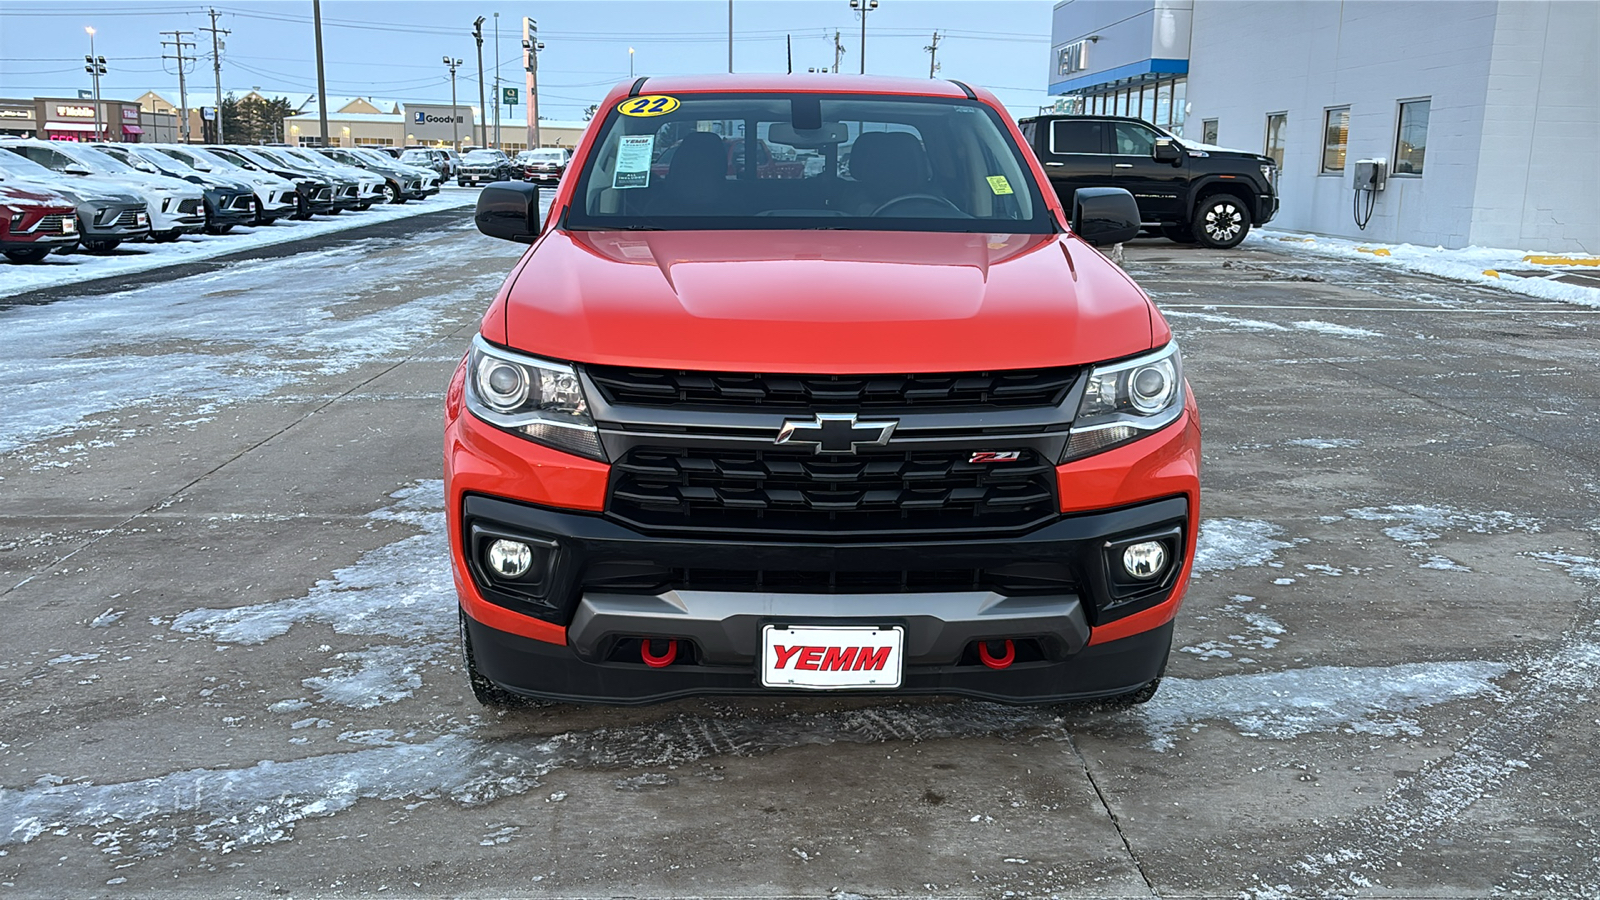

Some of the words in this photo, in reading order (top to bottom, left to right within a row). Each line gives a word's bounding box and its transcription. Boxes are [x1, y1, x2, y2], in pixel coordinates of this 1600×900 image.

[629, 98, 668, 113] 22
[968, 451, 1021, 463] Z71
[773, 645, 892, 671] YEMM
